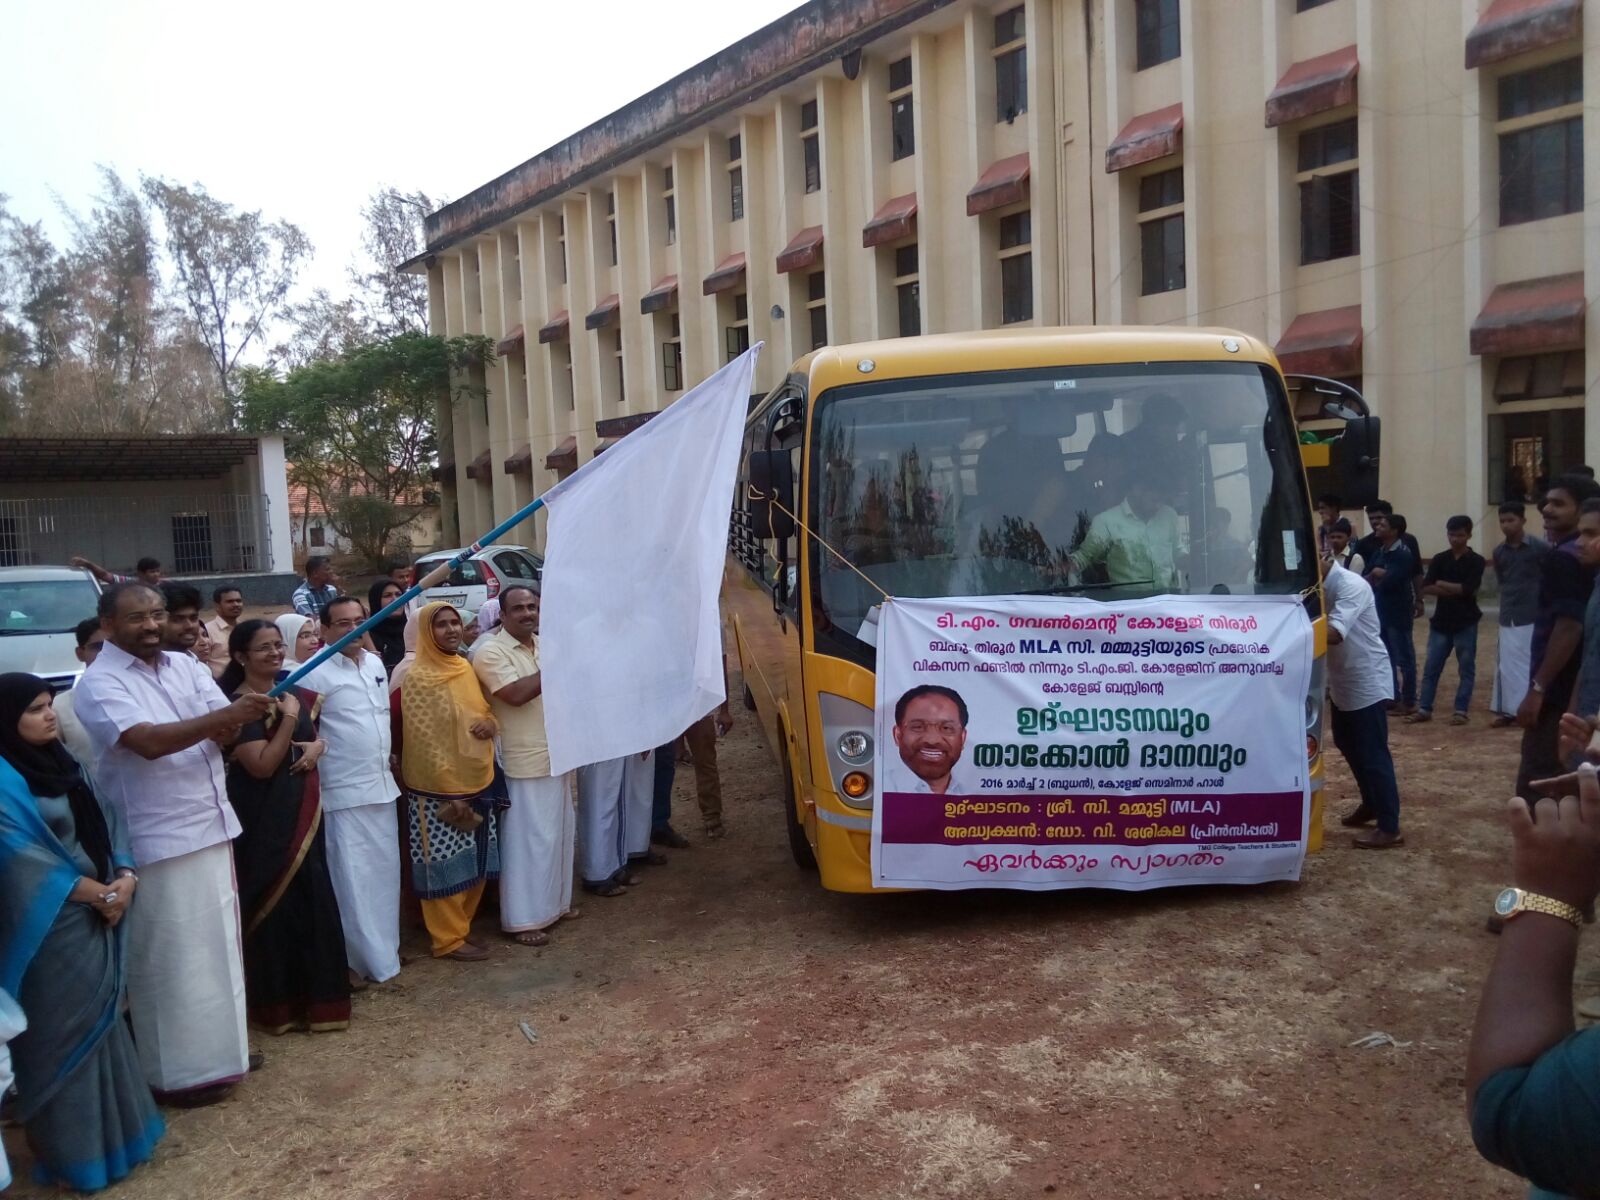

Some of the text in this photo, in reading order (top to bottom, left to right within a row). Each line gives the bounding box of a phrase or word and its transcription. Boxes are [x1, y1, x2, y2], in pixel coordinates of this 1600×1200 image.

[1127, 615, 1204, 632] കോളേജ്
[1209, 616, 1258, 633] തിരൂർ
[974, 641, 1016, 656] തിരൂർ
[1019, 640, 1064, 654] MLA
[1066, 638, 1096, 654] സി.
[1100, 639, 1204, 658] മമ്മുട്ടിയുടെ
[913, 659, 970, 672] വികസന
[1029, 661, 1074, 676] നിന്നും
[1042, 681, 1102, 696] കോളേജ്
[1016, 702, 1210, 738] ഉദ്ഘാടനവും
[973, 738, 1246, 773] താക്കോൽ ദാനവും
[980, 778, 1003, 788] 2016
[1039, 778, 1045, 788] 2
[944, 800, 1030, 817] ഉദ്ഘാടനം
[1083, 799, 1110, 814] സി.
[1119, 799, 1166, 818] മമ്മുട്ടി
[1170, 800, 1221, 815] (MLA)
[1093, 822, 1116, 838] വി.
[1124, 823, 1186, 839] ശശികല
[963, 850, 1224, 875] ഏവർക്കും സ്വാഗതം
